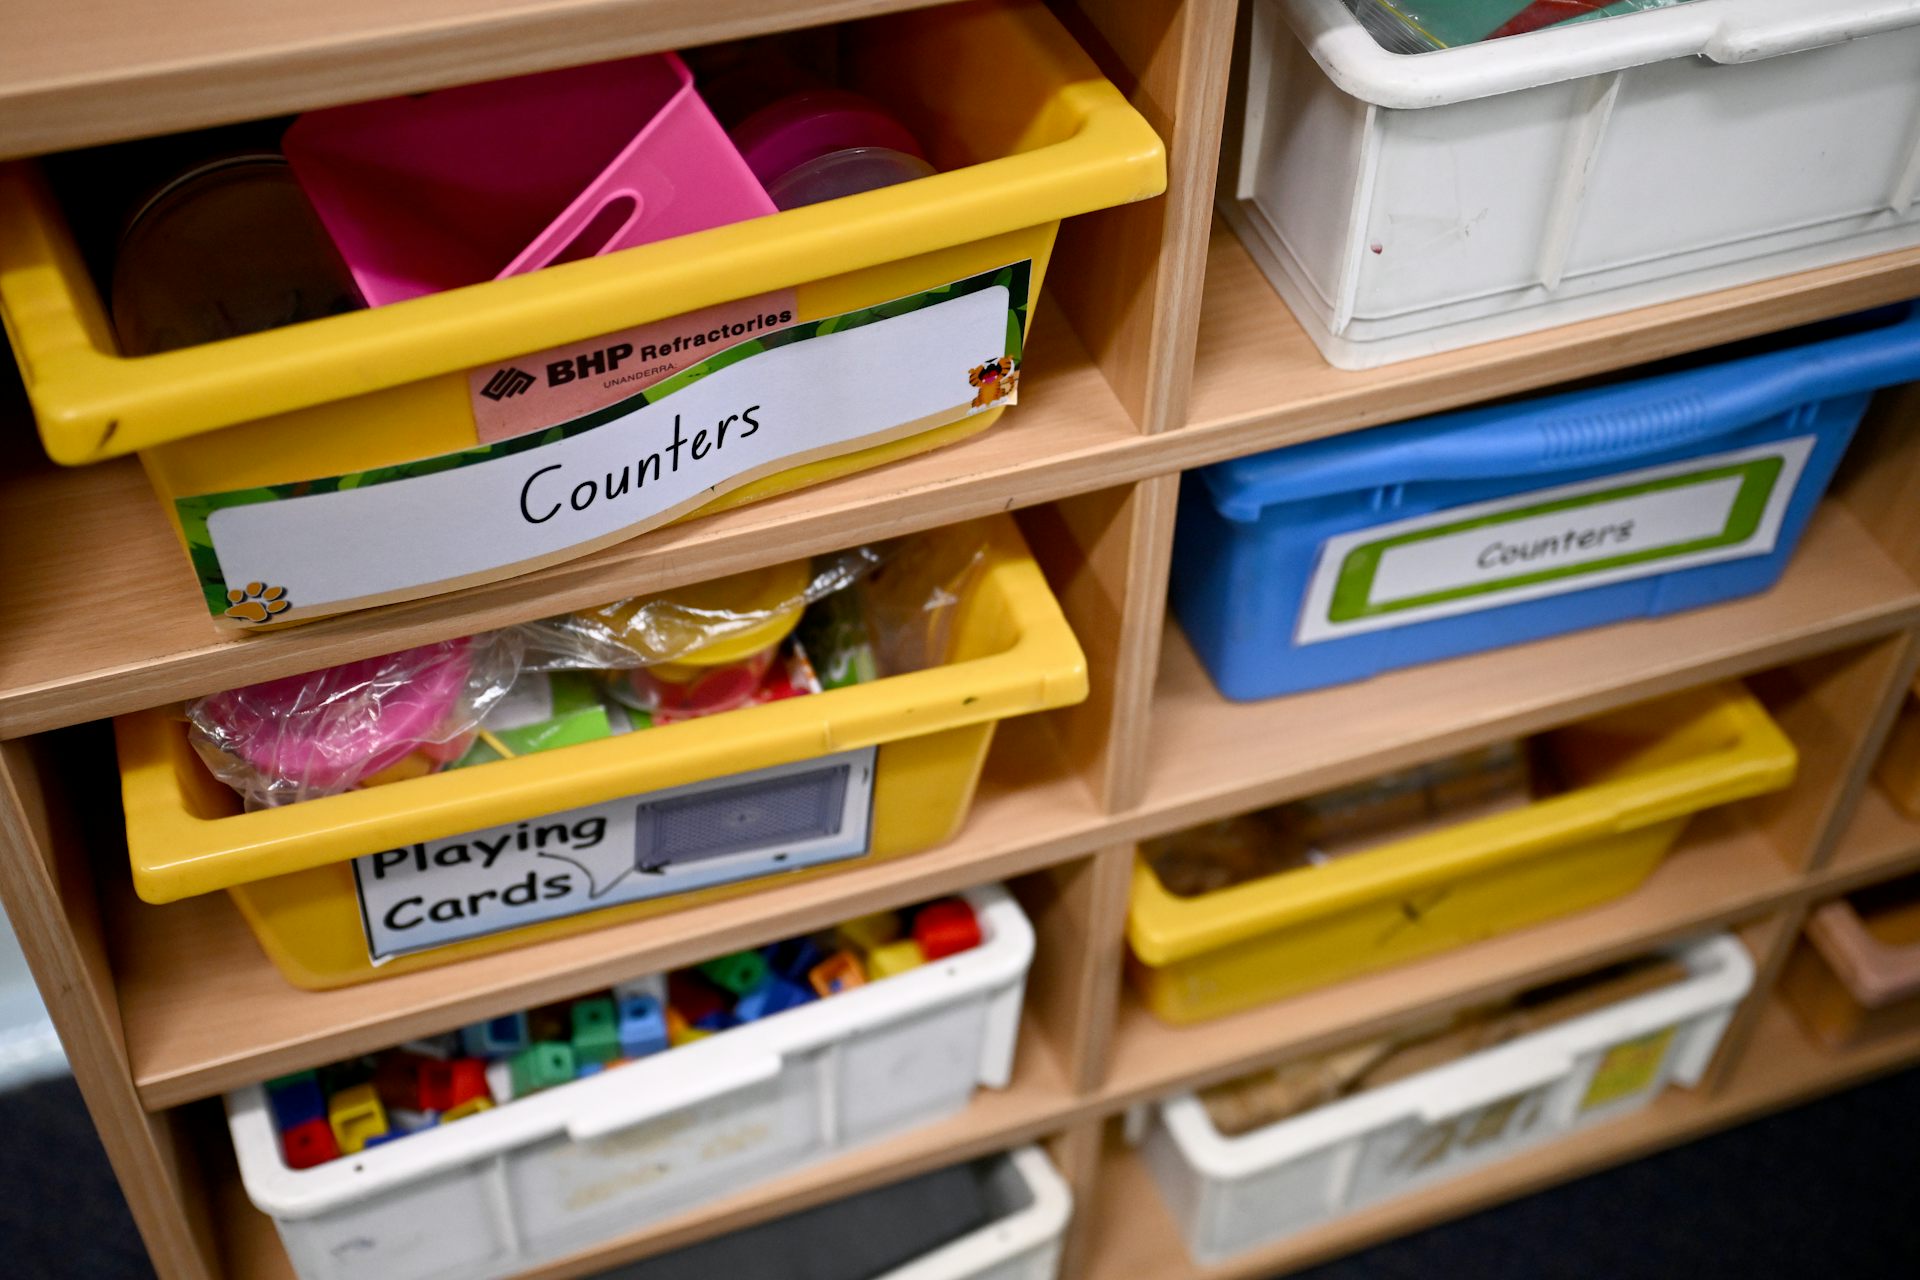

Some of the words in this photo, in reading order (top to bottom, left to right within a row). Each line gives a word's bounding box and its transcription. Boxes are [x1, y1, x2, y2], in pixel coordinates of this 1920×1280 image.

[546, 343, 633, 387] BHP
[640, 310, 792, 361] Refractories
[520, 405, 760, 523] Counters
[1477, 520, 1634, 569] Counters
[373, 817, 607, 879] Playing
[384, 872, 572, 931] Cards
